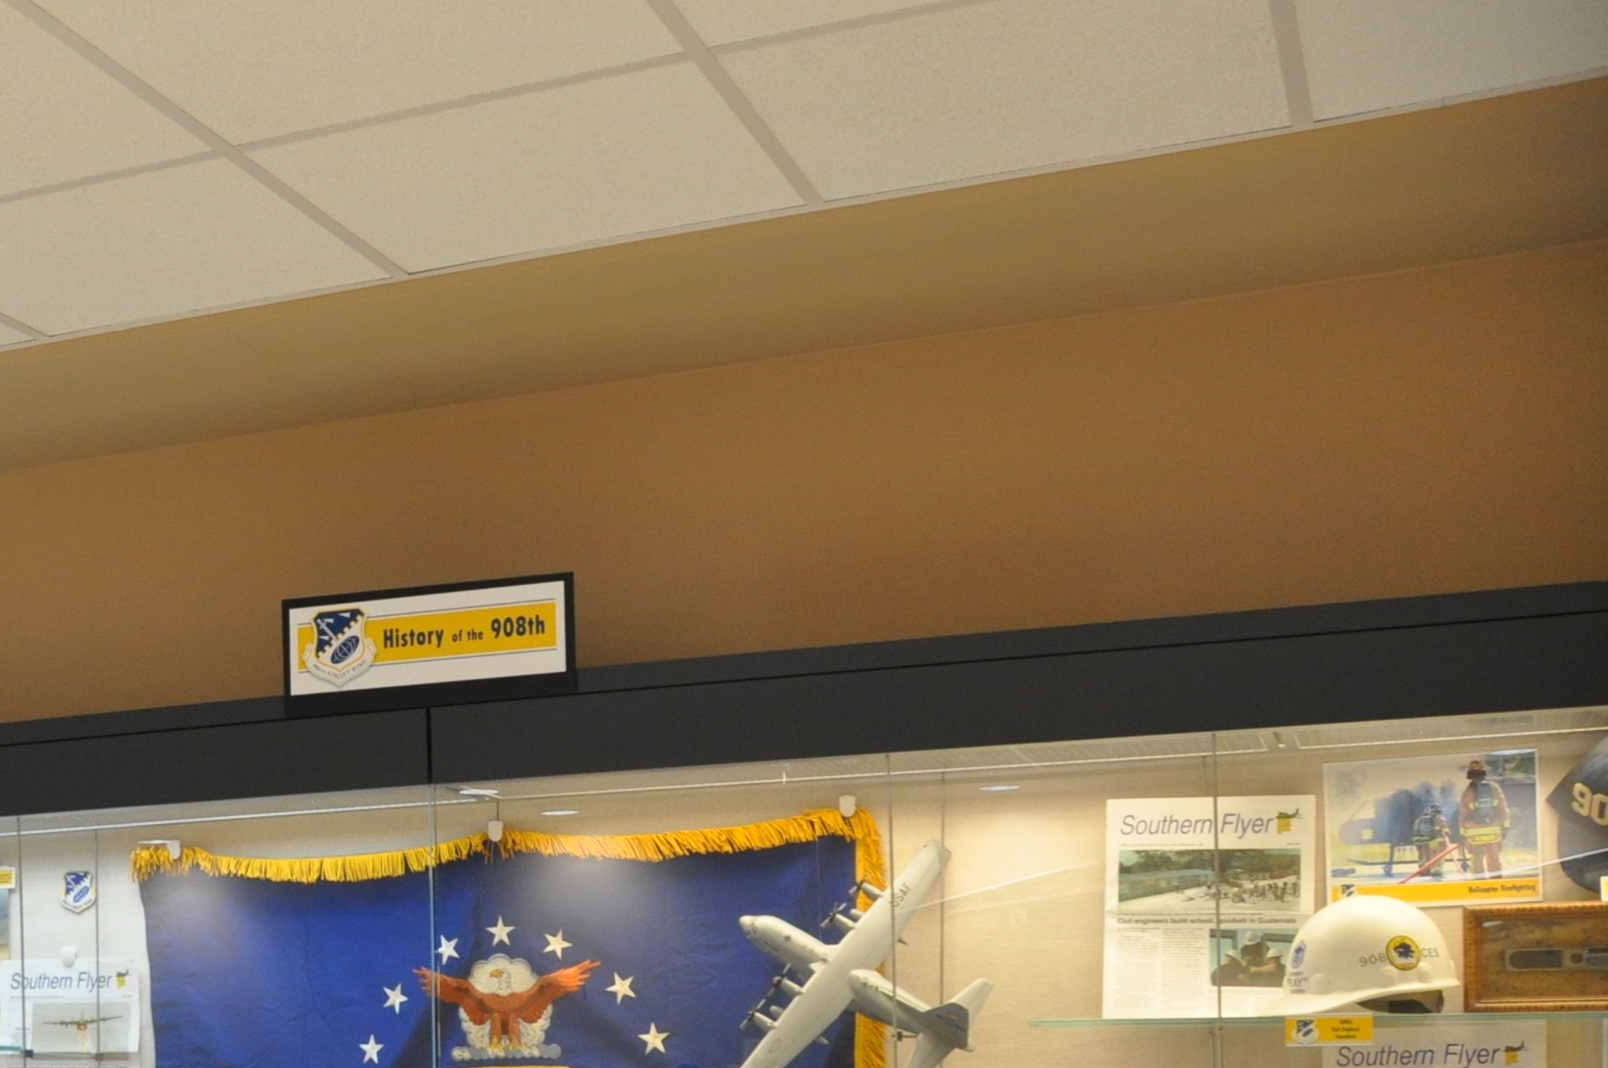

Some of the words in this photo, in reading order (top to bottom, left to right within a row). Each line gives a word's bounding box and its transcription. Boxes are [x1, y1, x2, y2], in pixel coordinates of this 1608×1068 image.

[383, 628, 445, 649] History
[452, 630, 463, 643] of
[467, 629, 484, 642] the
[491, 614, 546, 639] 908th
[1121, 814, 1213, 836] Southern
[1220, 813, 1274, 840] Flyer
[889, 882, 912, 908] USAF
[1134, 917, 1169, 926] engineers
[1217, 916, 1248, 925] oodwill
[1249, 916, 1256, 924] in
[1257, 916, 1297, 924] Guatemala
[1359, 953, 1387, 967] 908
[1420, 947, 1440, 958] CES
[10, 972, 72, 990] Southern
[77, 971, 112, 993] Flyer
[1336, 1045, 1435, 1067] Southern
